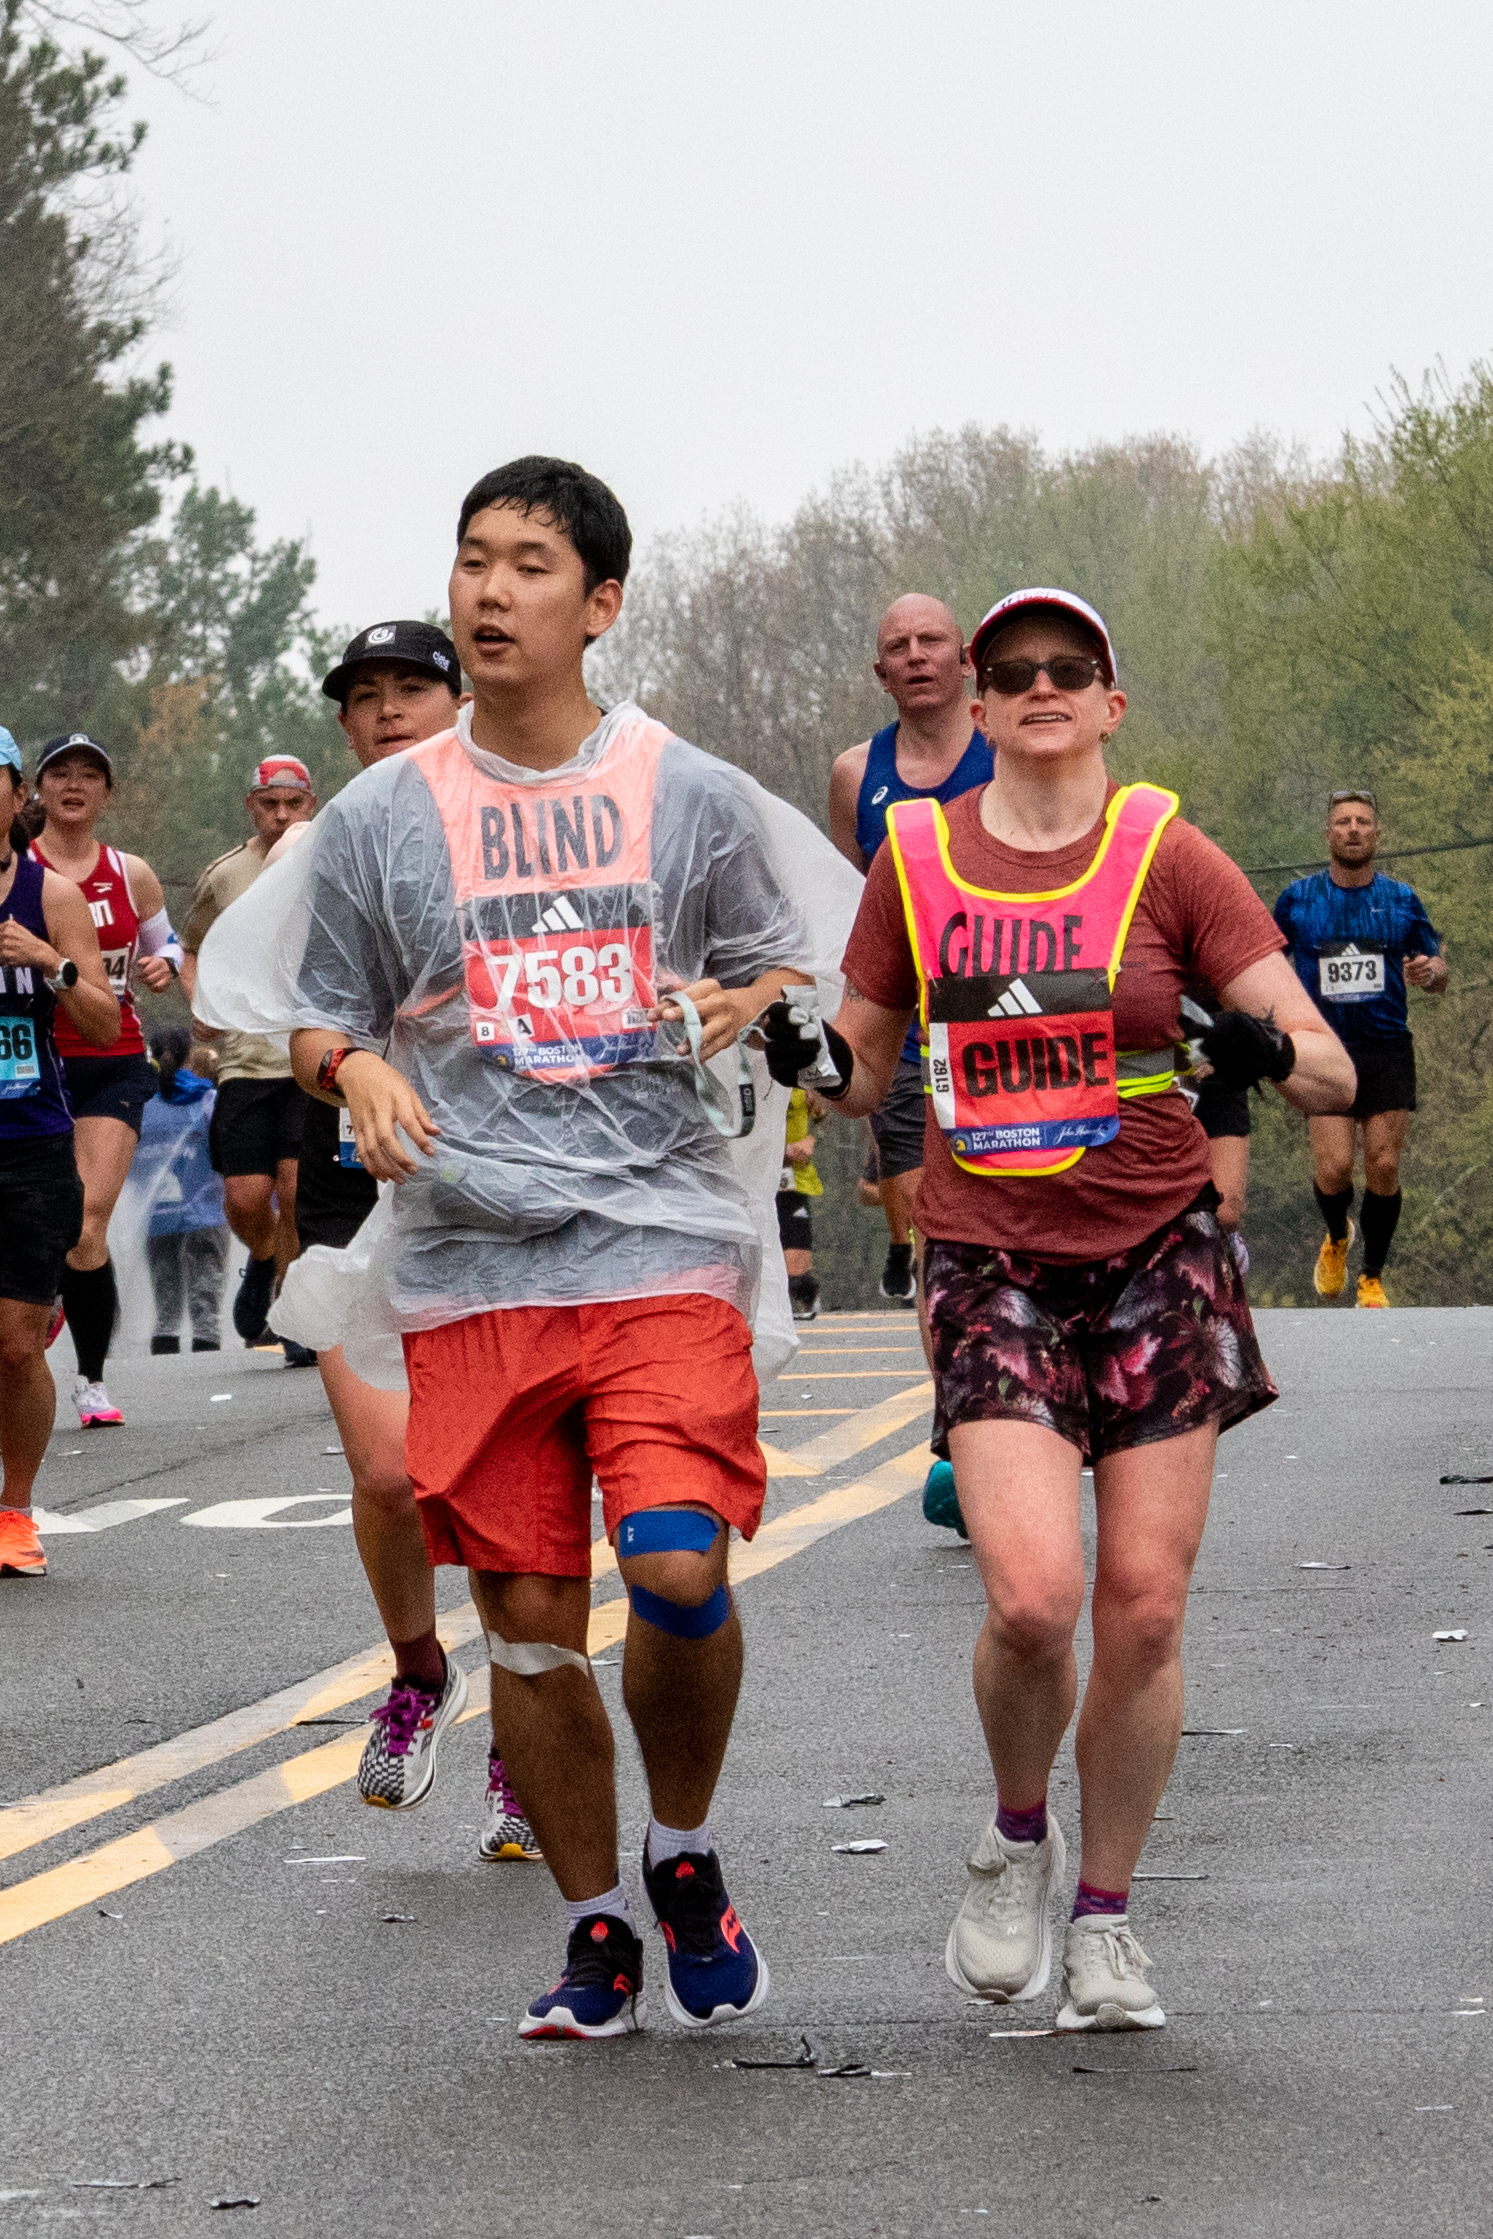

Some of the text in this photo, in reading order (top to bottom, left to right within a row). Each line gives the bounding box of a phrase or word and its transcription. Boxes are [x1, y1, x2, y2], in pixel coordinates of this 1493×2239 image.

[481, 794, 624, 880] BLIND
[939, 911, 1083, 977] GUIDE
[488, 943, 634, 1009] 7583
[1328, 960, 1377, 983] 9373
[481, 1026, 490, 1037] 8
[514, 1054, 582, 1065] MARATHO
[962, 1032, 1110, 1098] GUIDE
[933, 1059, 949, 1093] G162
[973, 1138, 1041, 1150] MARATHON
[995, 1128, 1040, 1140] BOSTON
